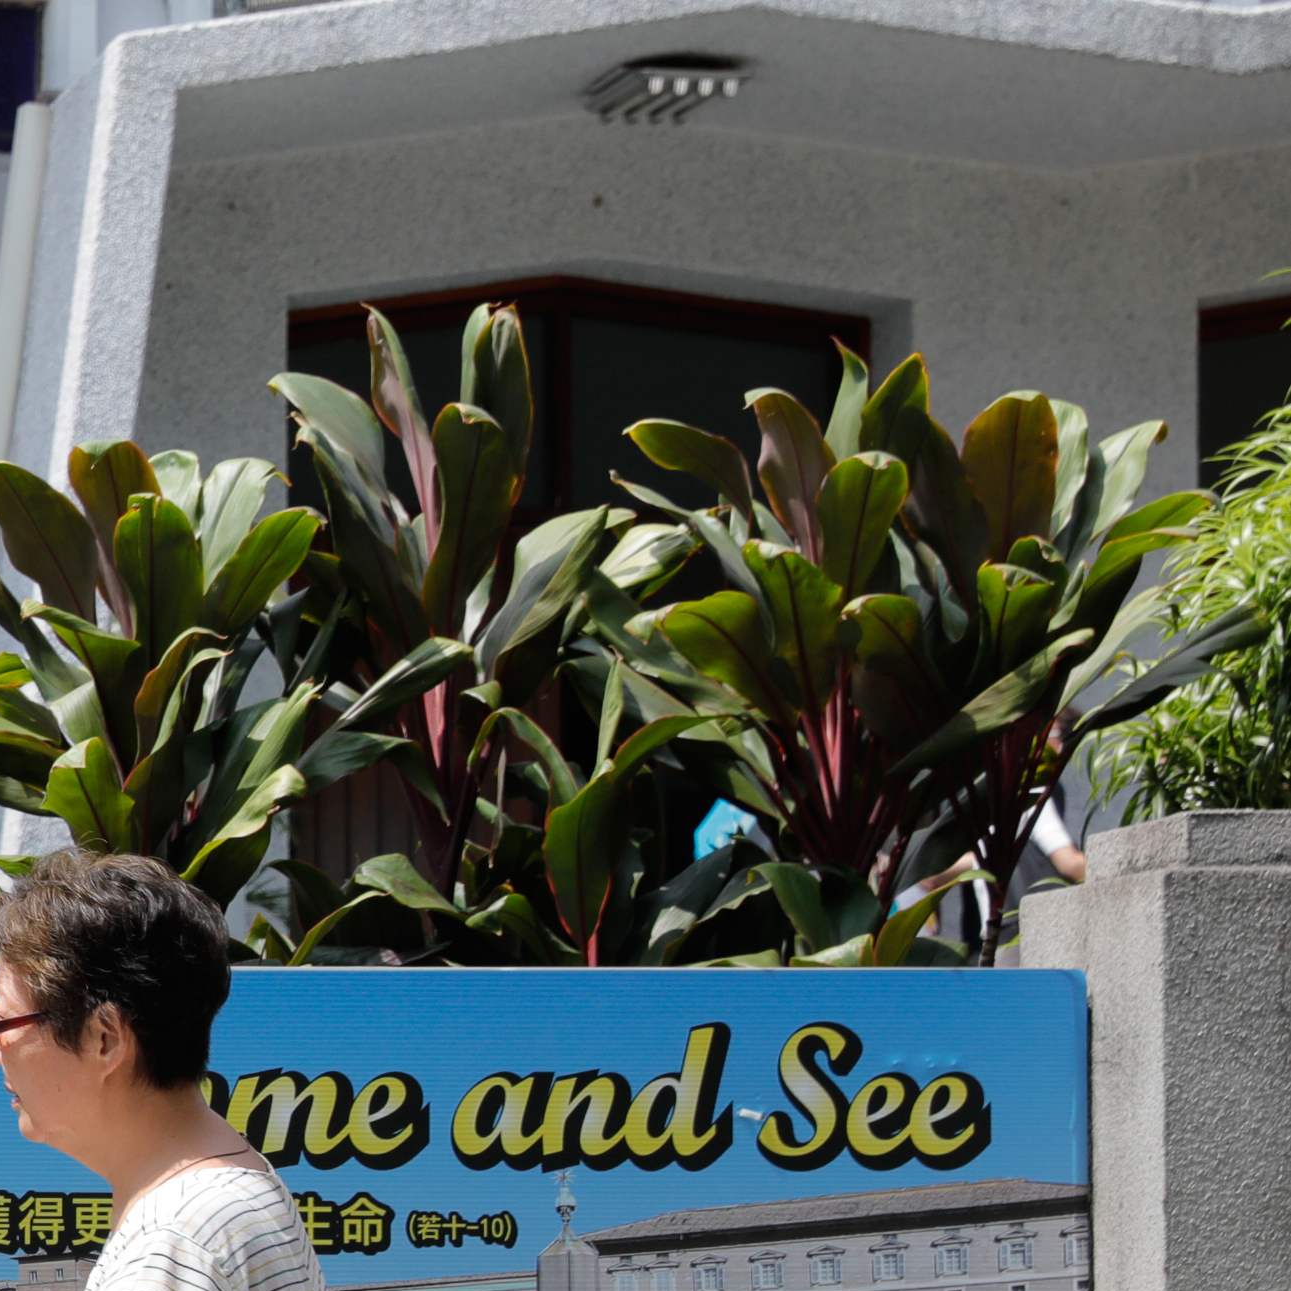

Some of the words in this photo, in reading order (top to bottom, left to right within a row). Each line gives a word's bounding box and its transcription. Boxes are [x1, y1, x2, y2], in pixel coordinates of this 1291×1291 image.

[200, 1068, 429, 1170] me
[452, 1022, 732, 1172] and
[758, 1021, 990, 1171] See
